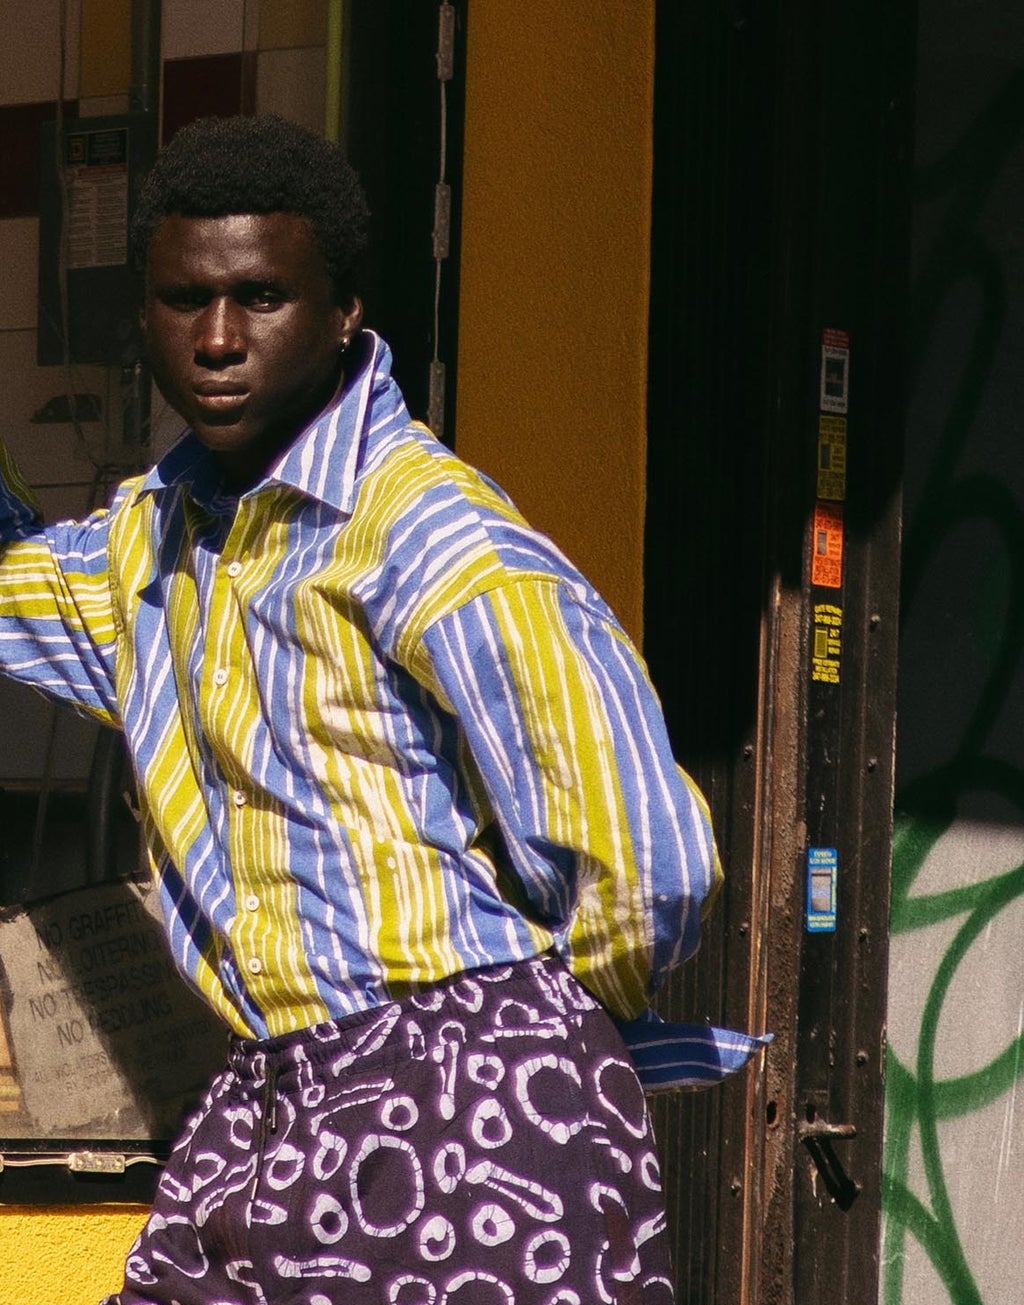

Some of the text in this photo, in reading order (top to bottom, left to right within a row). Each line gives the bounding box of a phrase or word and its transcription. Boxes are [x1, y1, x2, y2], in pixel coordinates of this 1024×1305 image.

[36, 921, 64, 950] NO
[29, 992, 57, 1022] NO
[56, 1019, 84, 1048] NO
